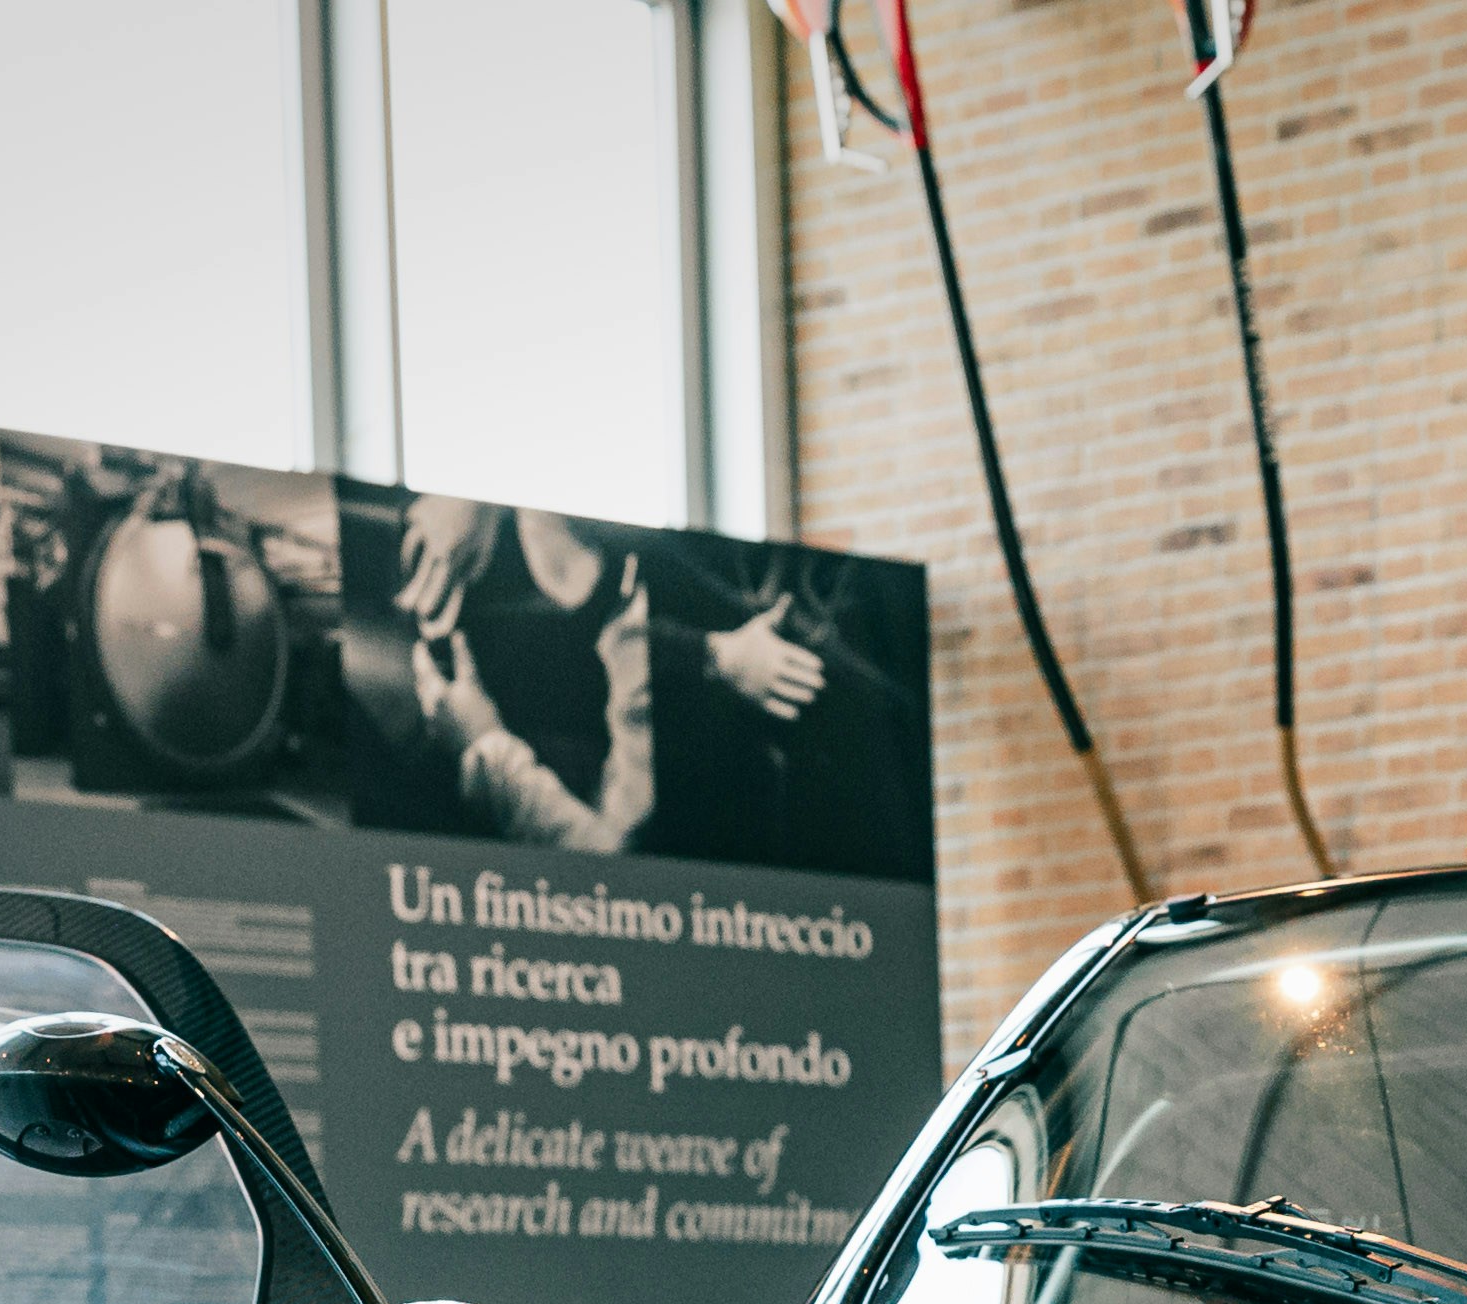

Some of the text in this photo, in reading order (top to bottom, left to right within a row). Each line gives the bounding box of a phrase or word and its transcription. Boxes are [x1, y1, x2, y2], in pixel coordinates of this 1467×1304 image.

[388, 865, 873, 958] Un finissimo intreccio
[392, 940, 622, 1004] tra ricerca
[392, 1008, 851, 1092] e impegno profondo
[397, 1107, 789, 1194] A delicate weave of
[402, 1181, 571, 1234] research
[579, 1185, 659, 1240] and
